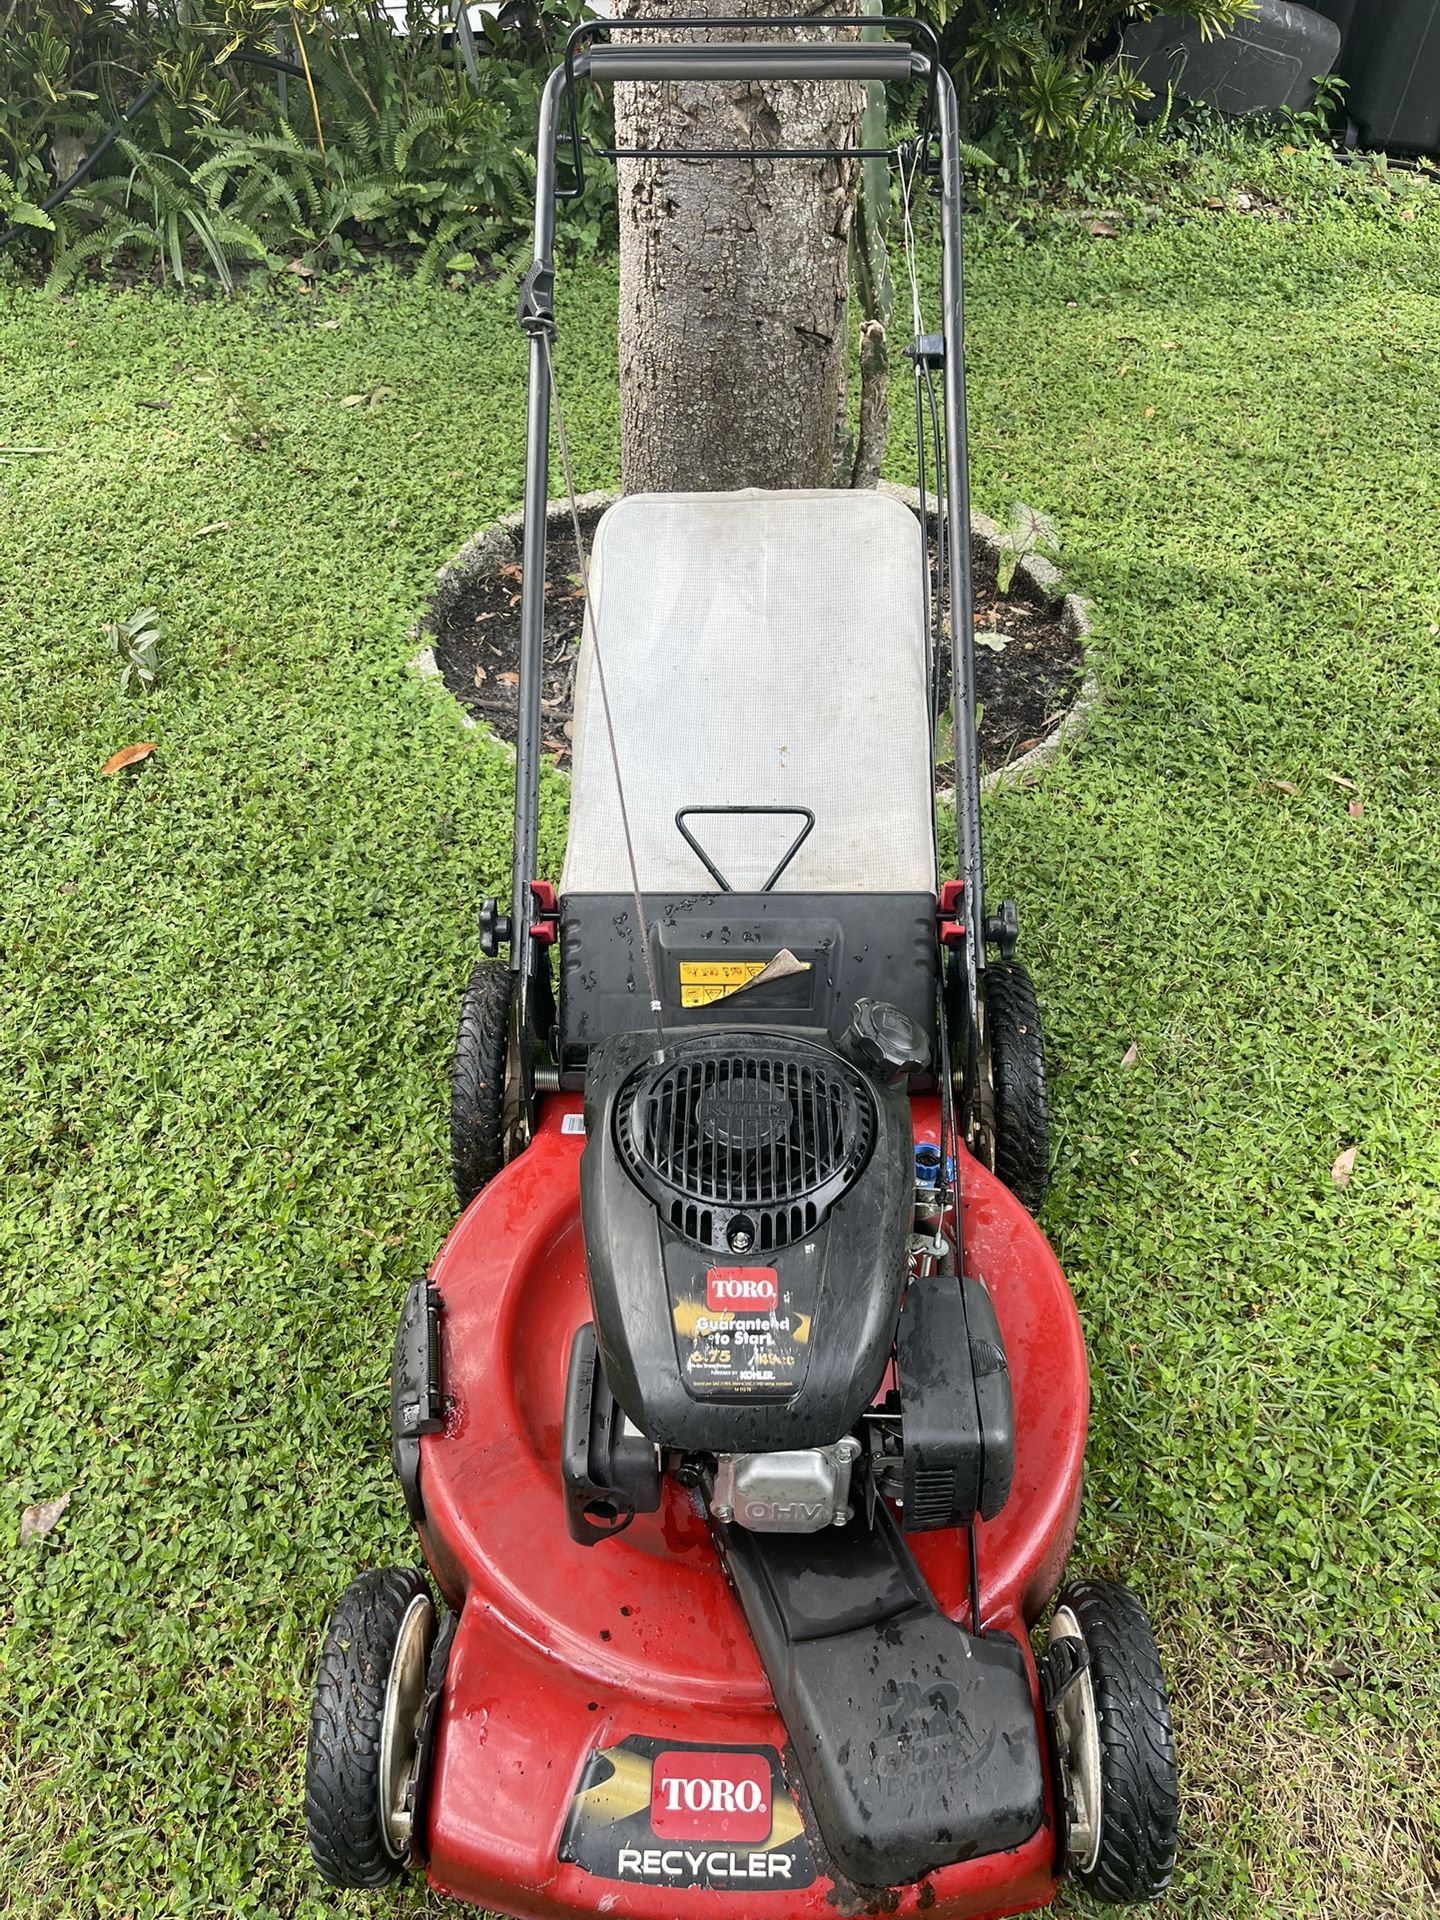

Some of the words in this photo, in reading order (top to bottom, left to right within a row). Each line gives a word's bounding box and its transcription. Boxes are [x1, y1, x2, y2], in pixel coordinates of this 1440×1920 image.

[712, 1280, 774, 1298] TORO
[715, 1332, 730, 1345] to
[745, 1502, 824, 1521] OHV
[661, 1778, 764, 1813] TORO
[618, 1849, 794, 1878] RECYCLER
